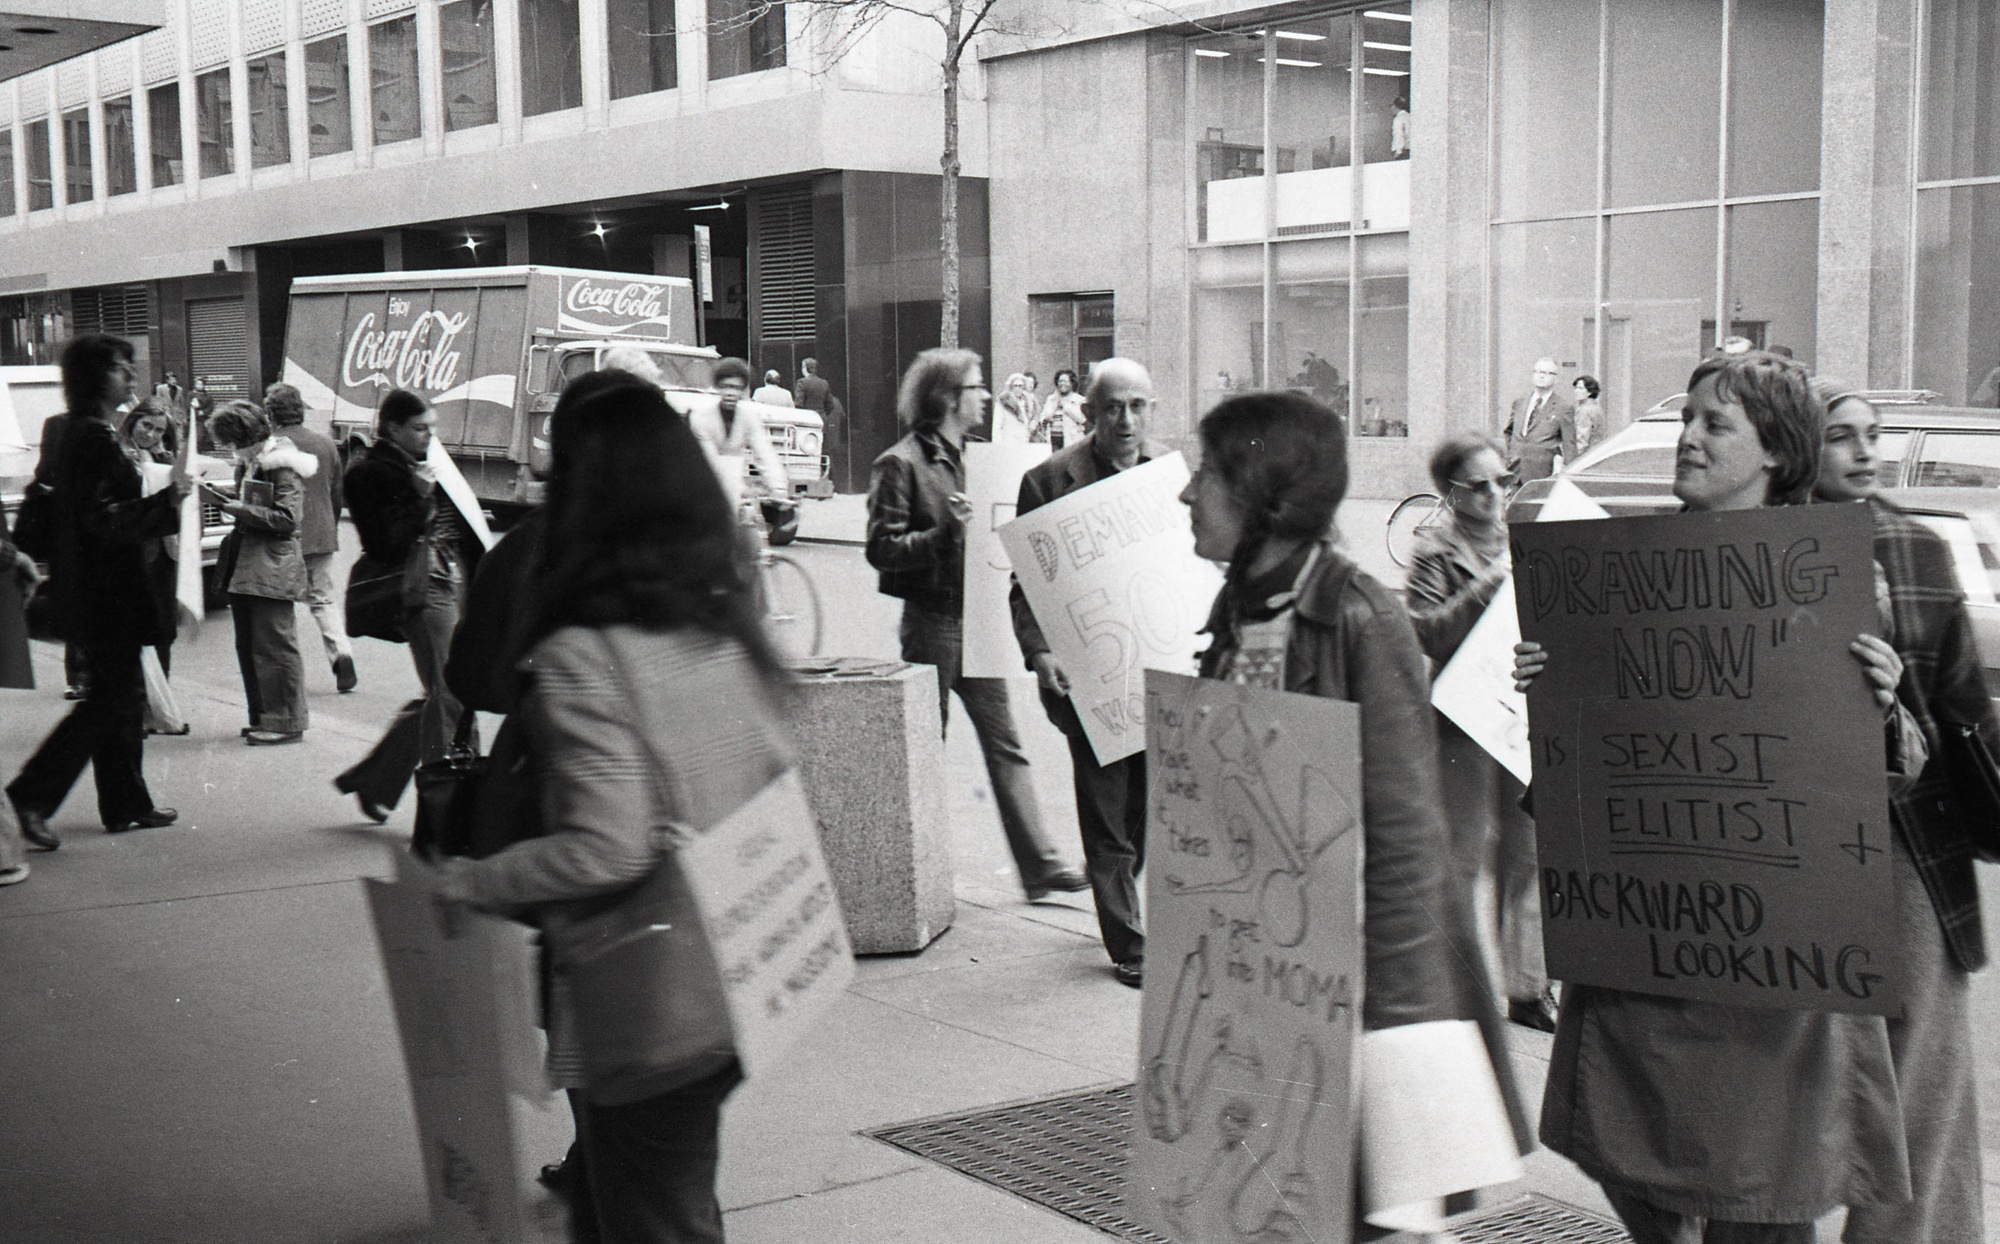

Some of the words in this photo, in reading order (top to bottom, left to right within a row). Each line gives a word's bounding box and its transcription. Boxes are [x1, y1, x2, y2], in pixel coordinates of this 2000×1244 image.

[388, 297, 411, 317] Enjoy
[567, 279, 664, 318] Coca-Cola
[343, 310, 471, 391] Coca-Cola
[1027, 474, 1183, 583] DEMAN
[1545, 734, 1566, 767] IS
[1601, 732, 1789, 783] SEXIST
[1605, 797, 1806, 846] ELITIST
[1544, 866, 1764, 940] BACKWARD
[1648, 933, 1884, 999] LOOKING
